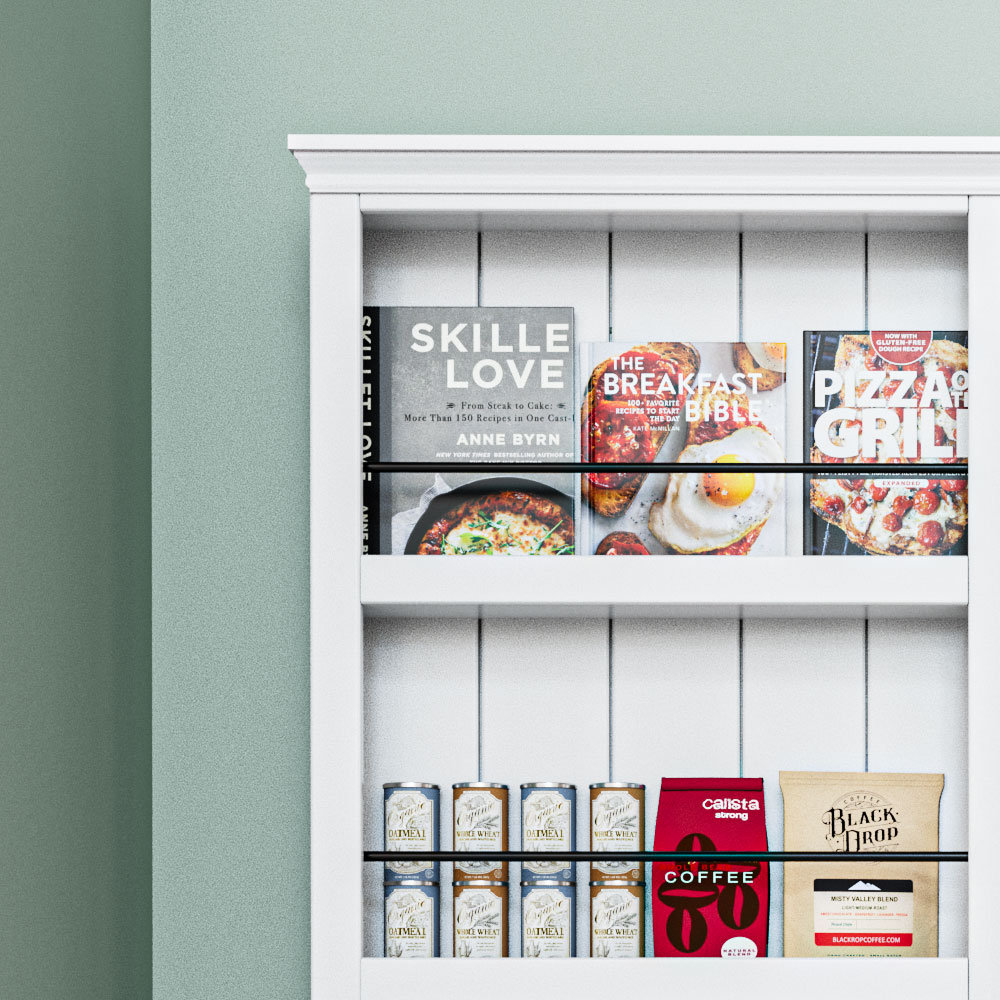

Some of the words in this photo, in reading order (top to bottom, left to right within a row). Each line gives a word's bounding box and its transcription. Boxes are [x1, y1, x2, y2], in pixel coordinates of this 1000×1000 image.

[410, 323, 570, 353] SKILLE
[446, 359, 565, 389] LOVE
[610, 356, 644, 371] THE
[603, 373, 763, 395] BREAKFAST
[814, 370, 952, 408] PIZZA
[461, 402, 484, 410] From
[487, 402, 512, 410] Steak
[527, 402, 553, 410] Cake:
[685, 400, 763, 422] BIBLE
[404, 414, 427, 422] More
[430, 414, 453, 422] Than
[456, 414, 473, 422] 150
[477, 414, 511, 424] Recipes
[514, 414, 523, 422] in
[526, 414, 545, 422] One
[456, 434, 506, 446] ANNE
[512, 434, 560, 446] BYRN
[715, 812, 749, 821] strong
[823, 807, 898, 838] BLACK
[838, 827, 898, 852] DROP
[664, 871, 754, 884] COFFEE
